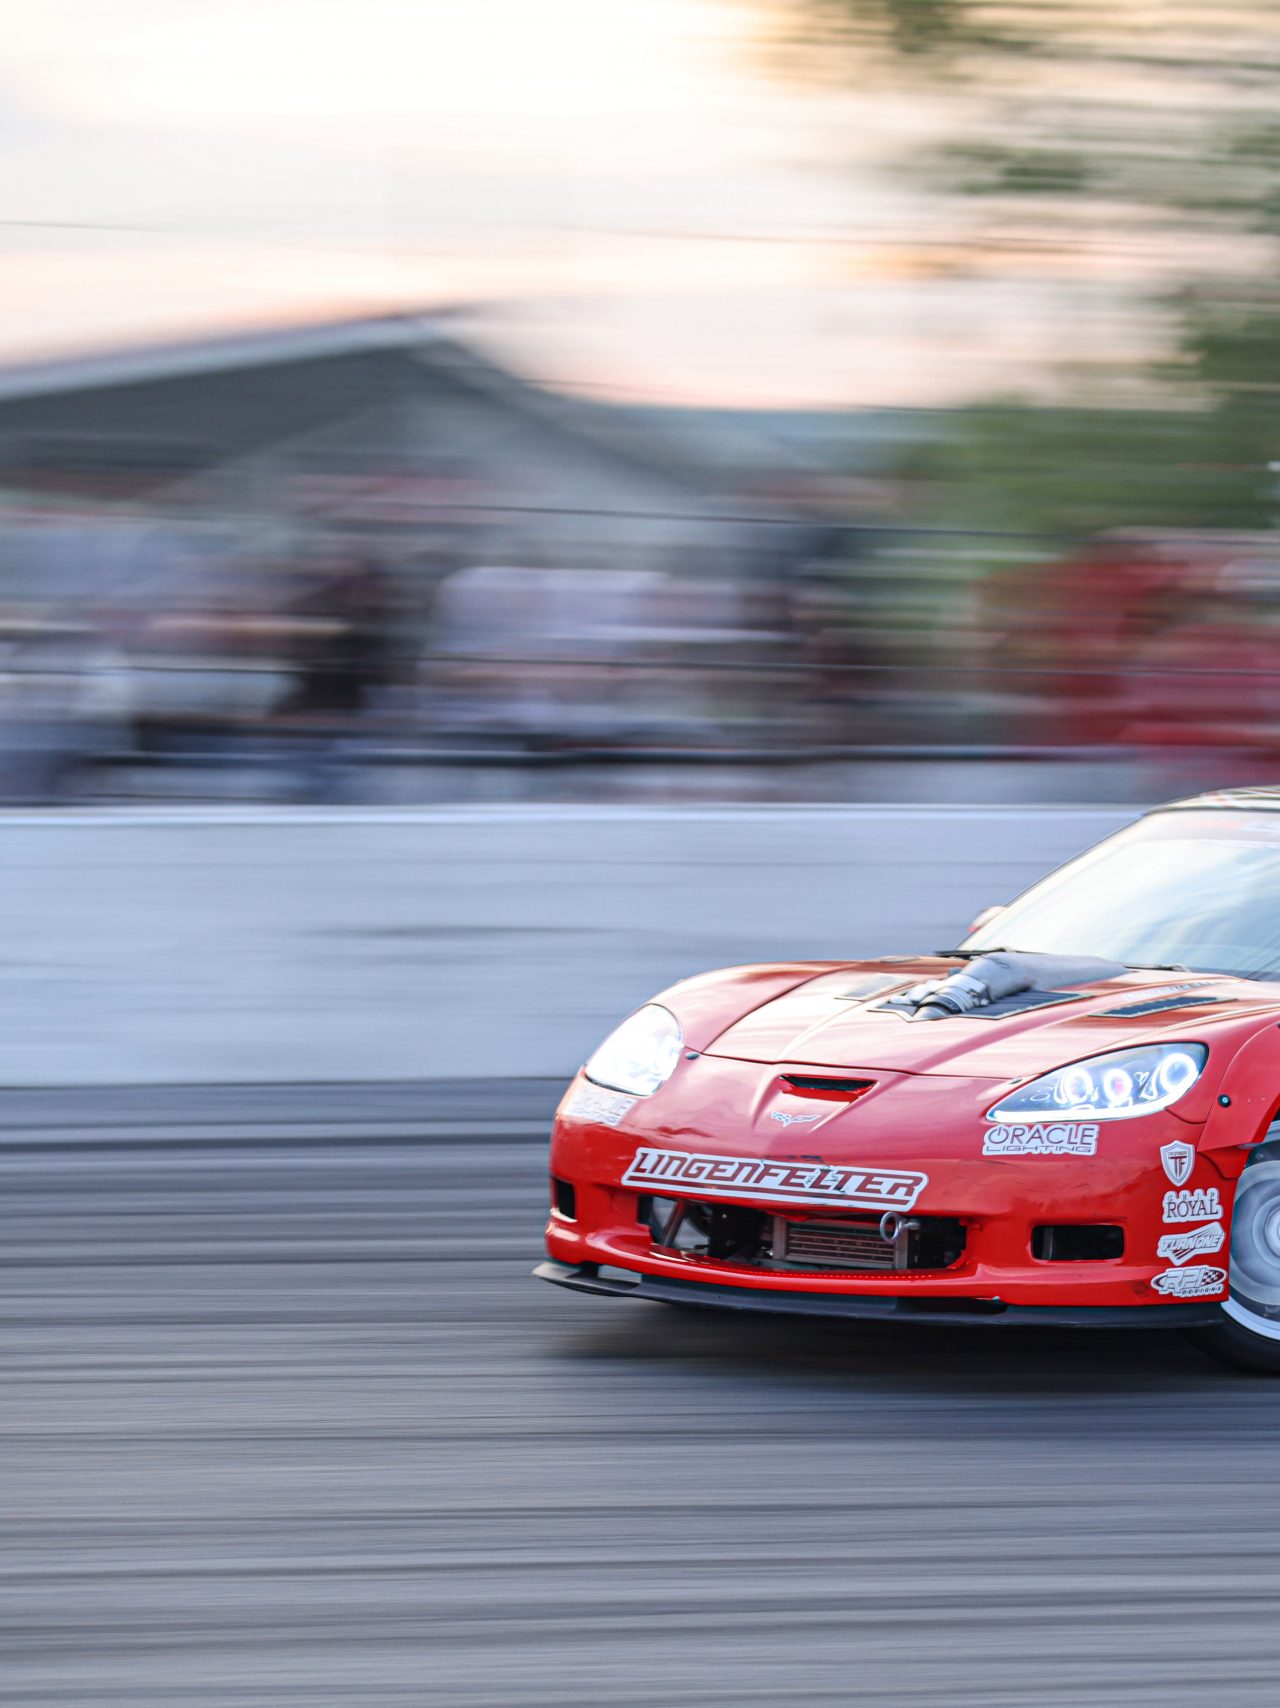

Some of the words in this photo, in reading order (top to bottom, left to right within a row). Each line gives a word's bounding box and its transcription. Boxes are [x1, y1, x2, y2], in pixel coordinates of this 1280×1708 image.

[987, 1126, 1095, 1145] ORACLE
[986, 1145, 1093, 1153] LIGHTING
[631, 1152, 924, 1197] LINGENFELTER
[1167, 1192, 1215, 1201] GRIP
[1166, 1199, 1219, 1218] ROYAL
